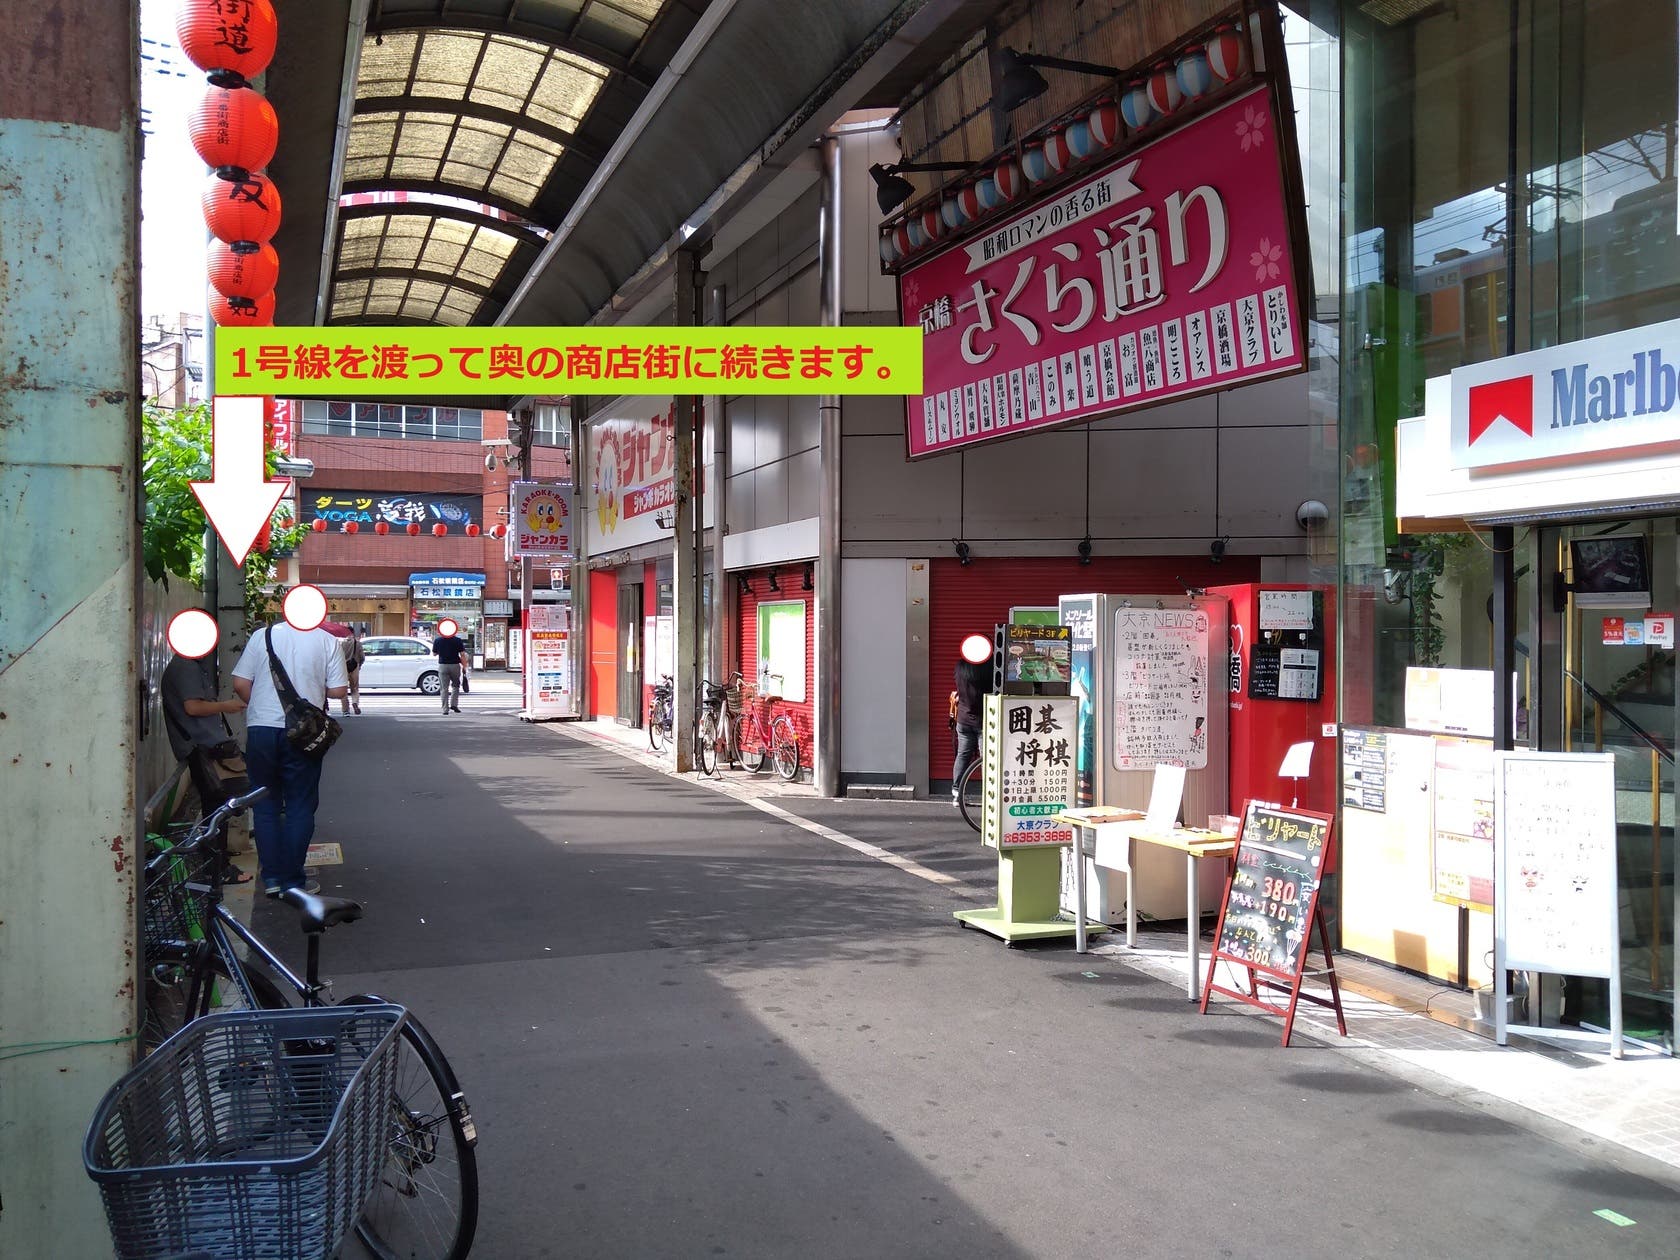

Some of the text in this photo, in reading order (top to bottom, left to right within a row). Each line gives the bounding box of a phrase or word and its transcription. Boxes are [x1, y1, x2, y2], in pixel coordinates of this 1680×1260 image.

[983, 177, 1112, 261] 昭和ロマンの香る街
[957, 185, 1230, 365] さくら通り
[1191, 317, 1206, 374] オアシス
[1216, 309, 1232, 367] 京橋酒場
[1243, 300, 1259, 363] 大京クラブ
[1268, 294, 1284, 355] とりいし
[1047, 366, 1057, 407] このみ
[1103, 344, 1115, 396] 京橋会館
[1550, 348, 1680, 429] Marlb
[623, 403, 675, 488] ジャン
[316, 496, 373, 509] ダーツ
[521, 534, 568, 545] ジャンカラ
[1010, 628, 1056, 638] ビリヤード 3F
[1009, 704, 1062, 735] 囲碁
[1015, 738, 1072, 767] 将棋
[1039, 786, 1067, 794] 1000円
[1011, 830, 1073, 844] 6353-3696
[1247, 816, 1327, 851] ビリヤード
